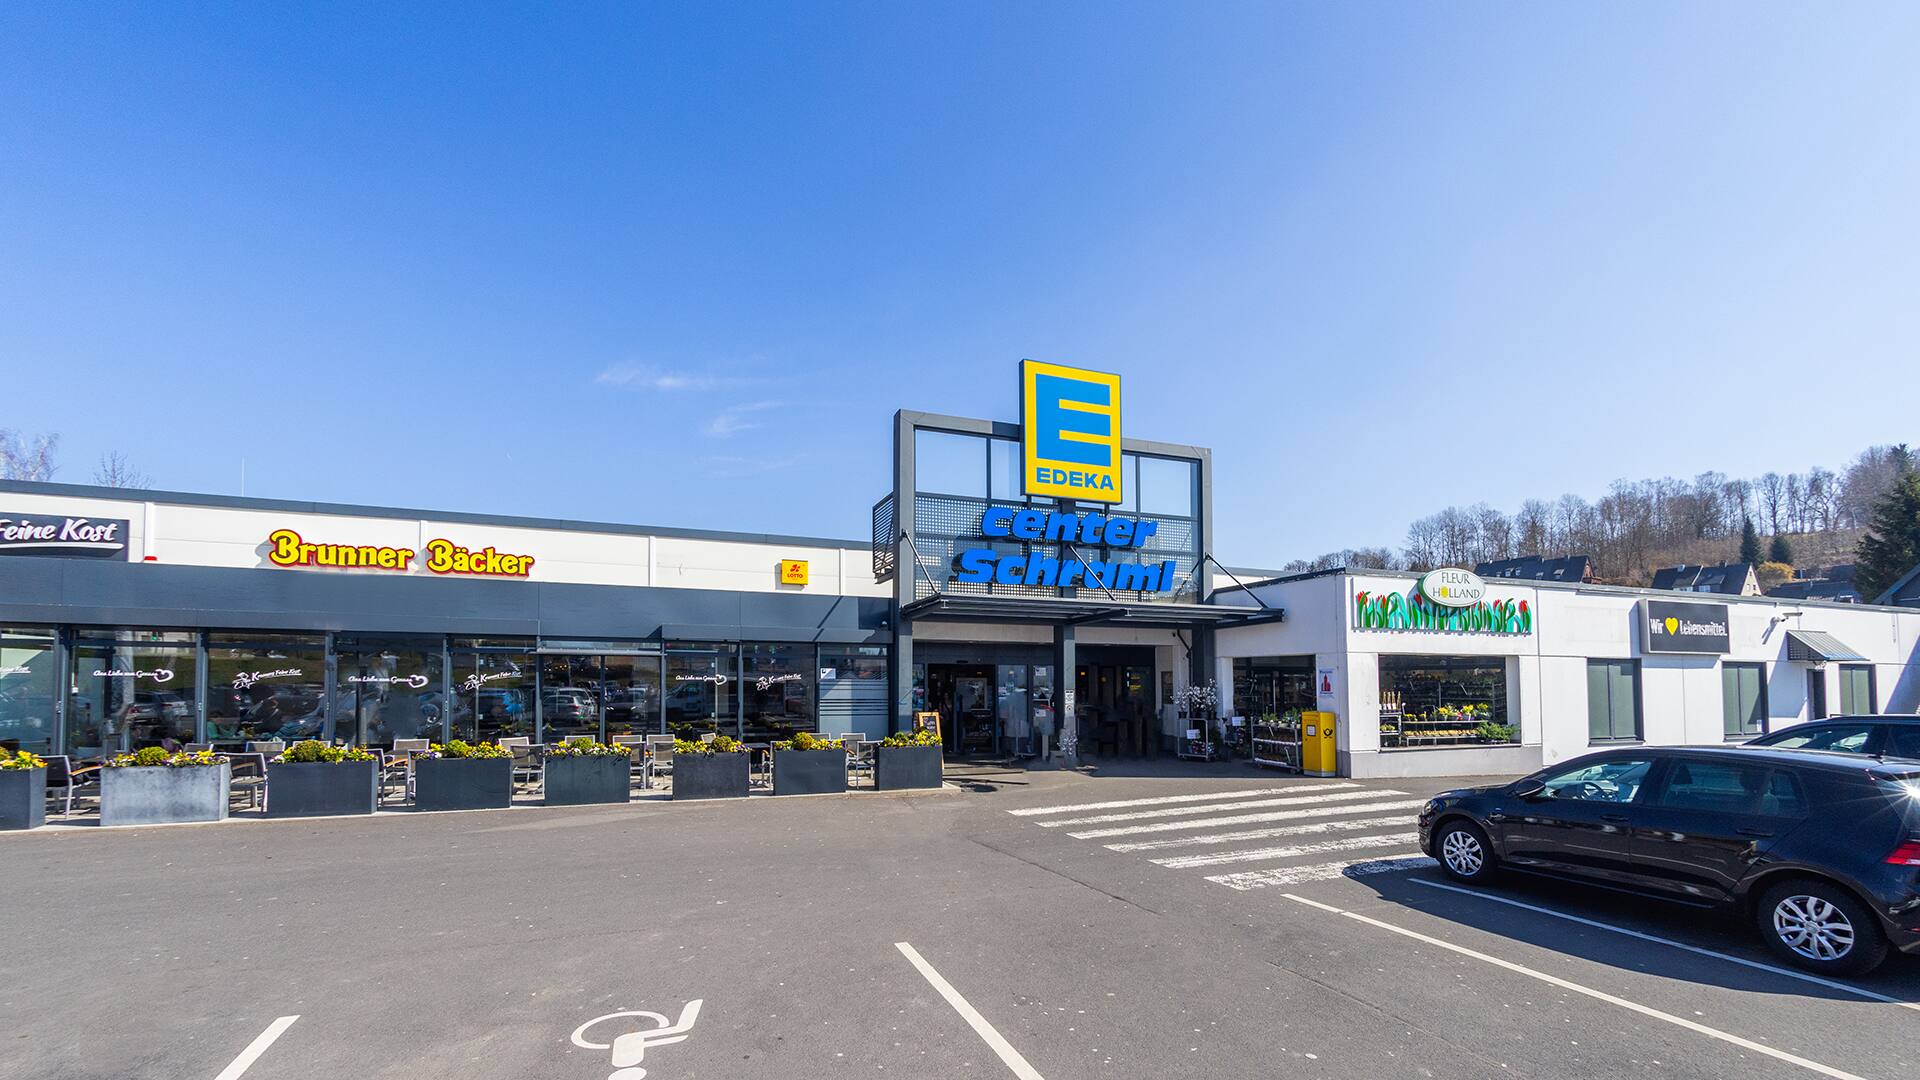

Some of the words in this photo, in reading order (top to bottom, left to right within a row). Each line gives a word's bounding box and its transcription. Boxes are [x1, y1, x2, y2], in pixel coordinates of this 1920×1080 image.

[1036, 467, 1115, 491] EDEKA
[59, 518, 118, 542] Kost
[981, 506, 1158, 548] center
[269, 529, 415, 571] Brunner
[427, 538, 535, 577] Bäcker
[957, 547, 1177, 592] Schraml
[1441, 572, 1471, 585] FLEUR
[1432, 586, 1481, 599] HOLLAND
[1650, 618, 1665, 635] Wir
